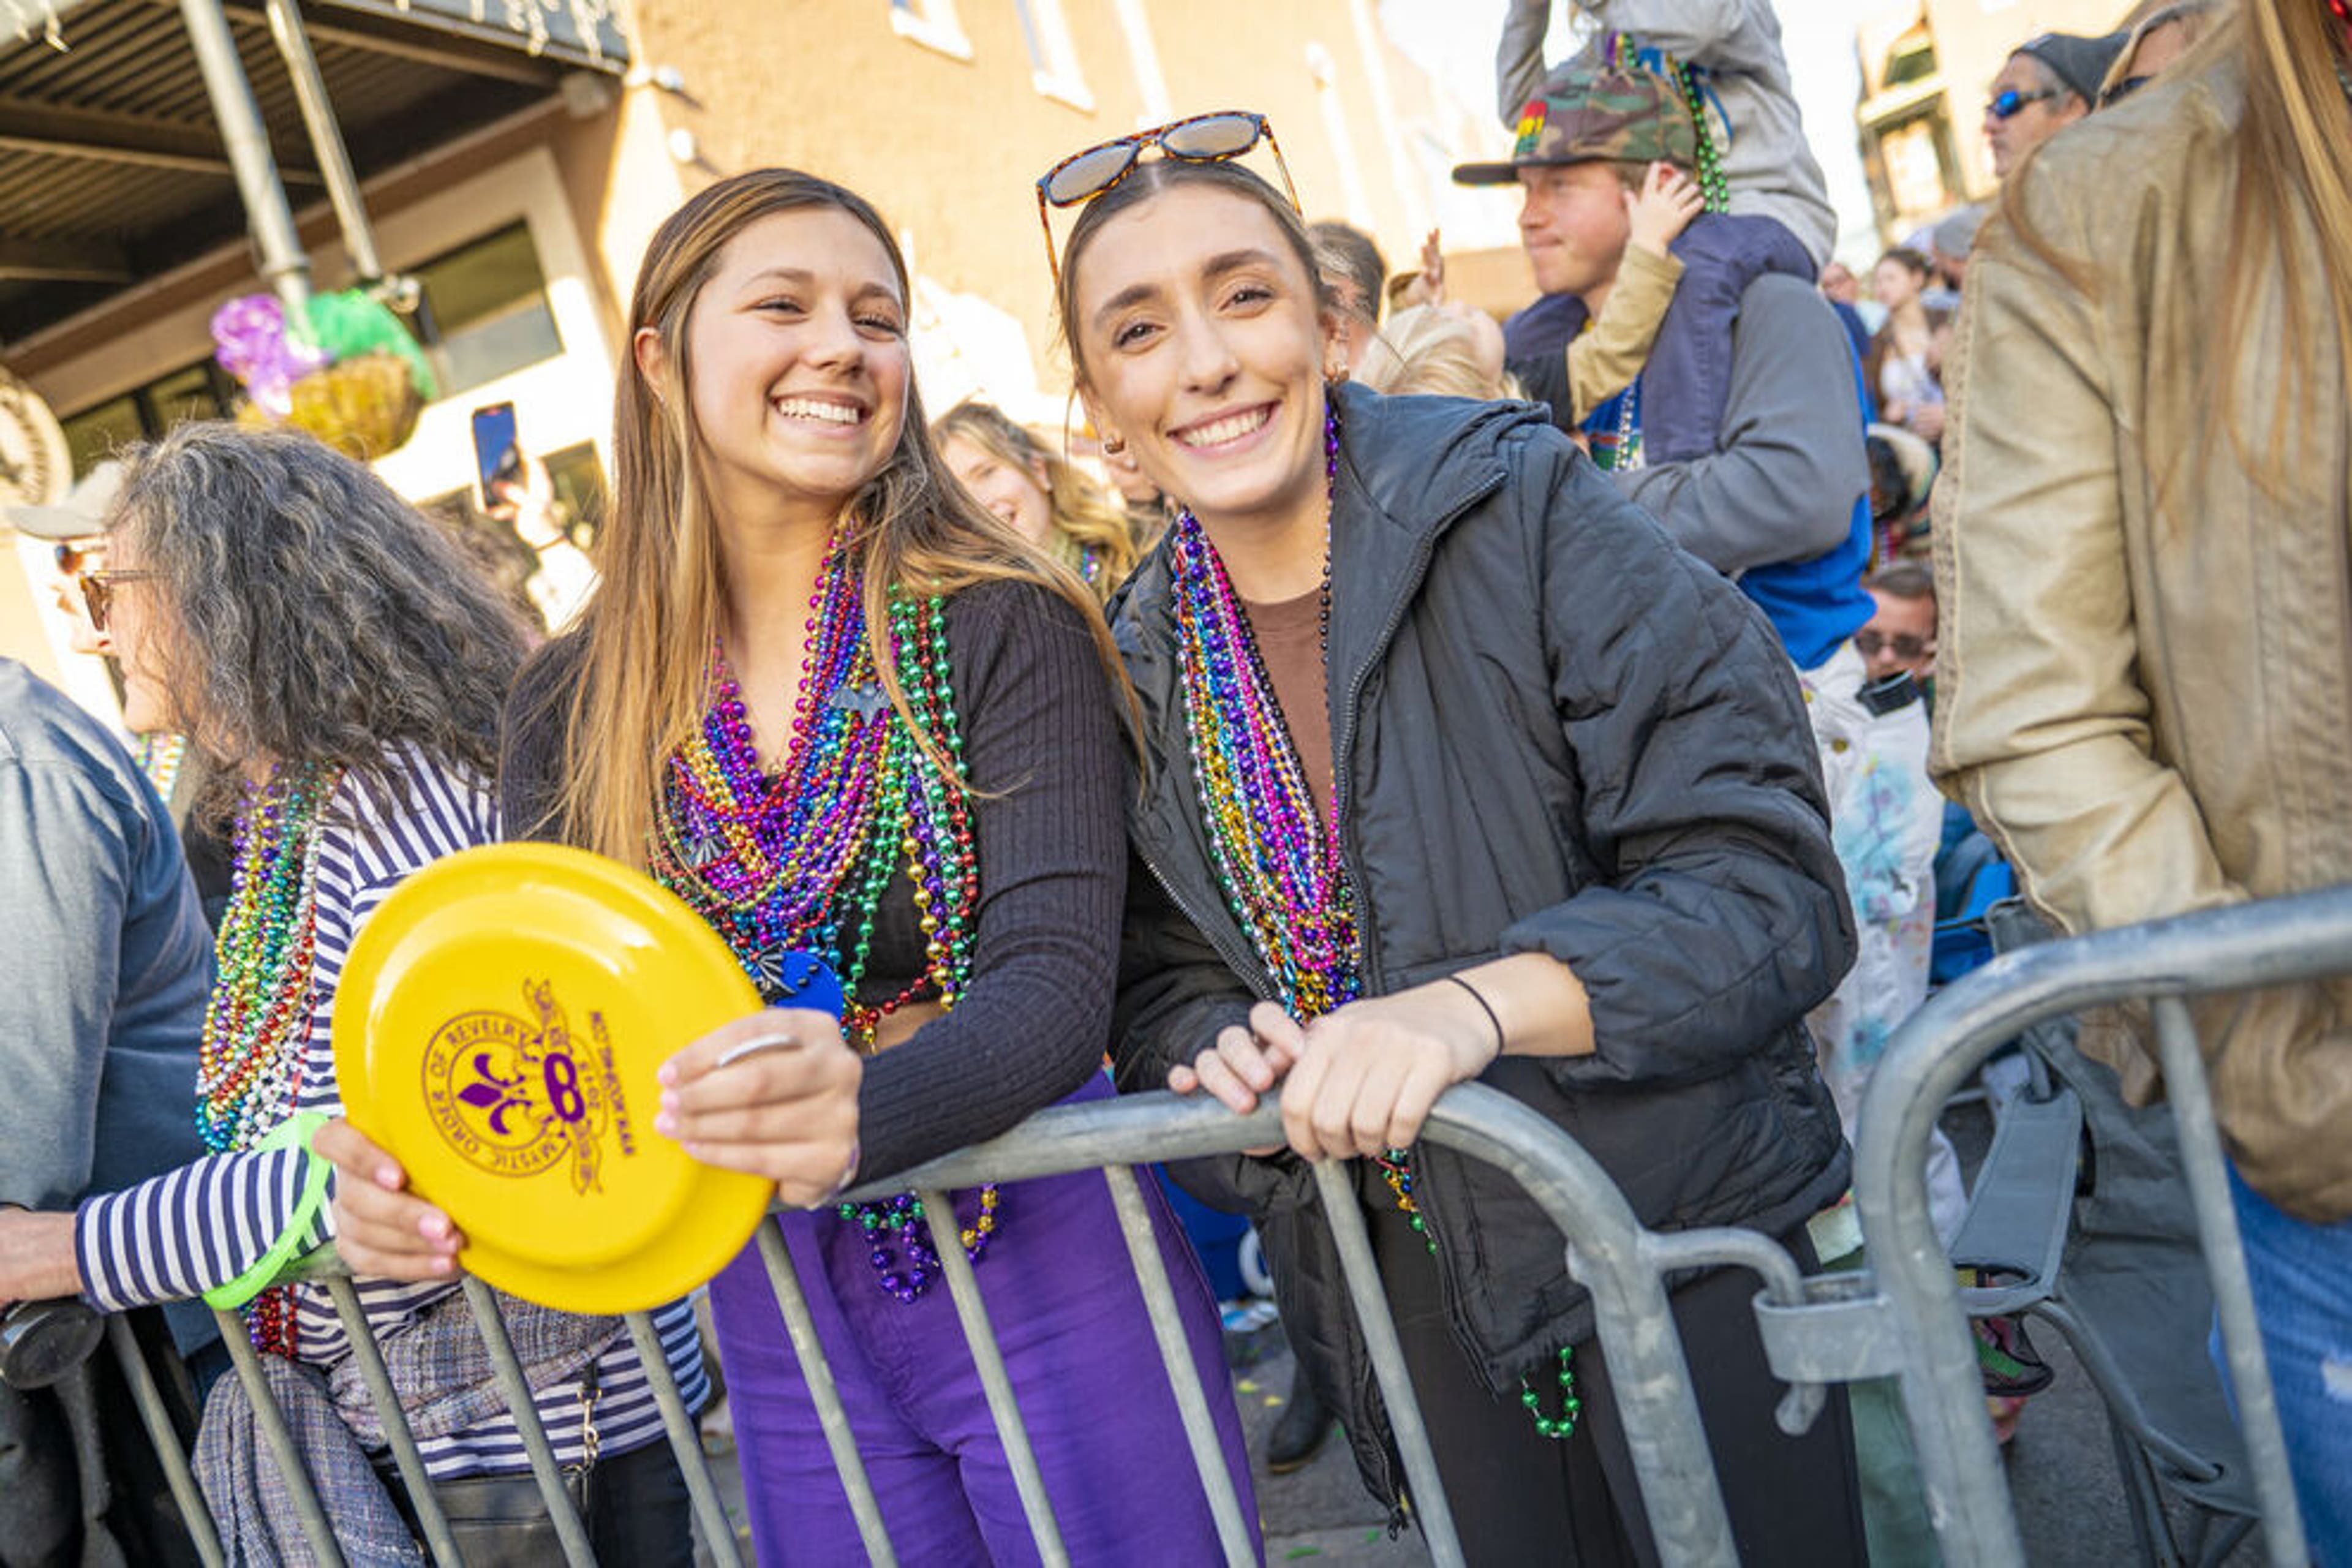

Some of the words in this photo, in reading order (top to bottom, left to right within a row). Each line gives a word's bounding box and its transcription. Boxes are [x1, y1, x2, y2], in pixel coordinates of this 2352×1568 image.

[430, 1049, 447, 1077] OF
[431, 1090, 480, 1155] ORDER
[494, 1140, 558, 1169] MYSTIC
